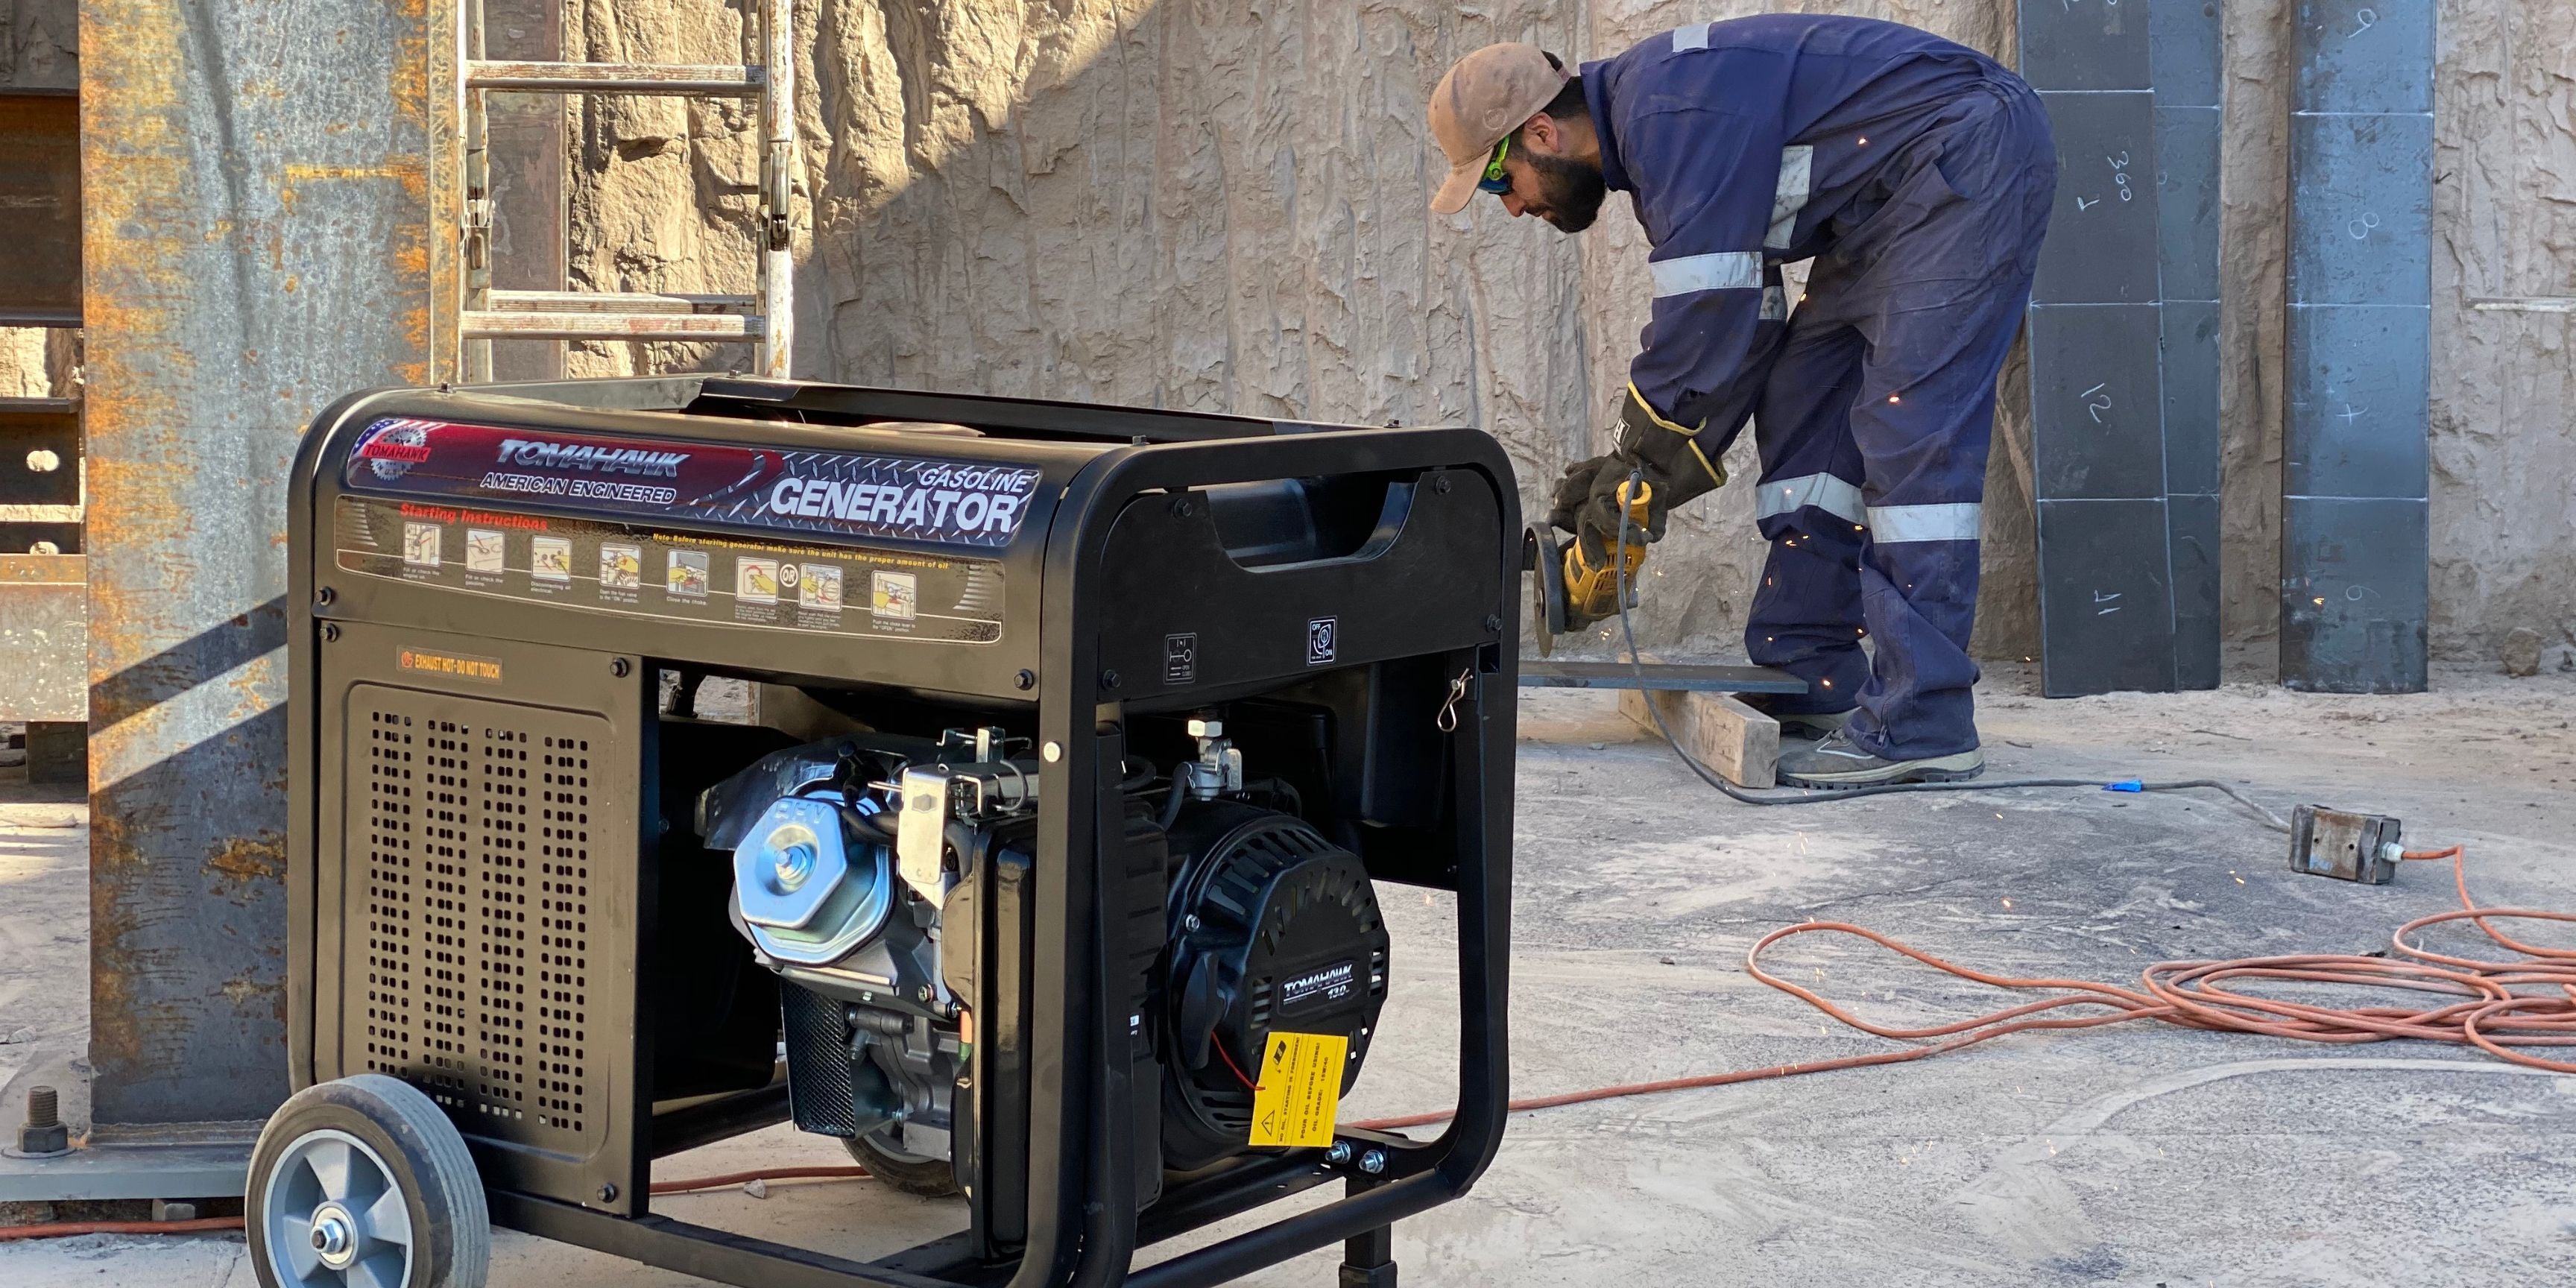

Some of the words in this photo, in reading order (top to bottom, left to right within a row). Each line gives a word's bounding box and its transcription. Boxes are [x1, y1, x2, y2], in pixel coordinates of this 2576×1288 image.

[2348, 212, 2379, 240] 8
[366, 443, 429, 461] TOMAHAWK
[496, 438, 691, 478] TOMAHAWK
[480, 471, 569, 495] AMERICAN
[568, 479, 677, 504] ENGINEERED
[919, 467, 1032, 493] GASOLINE
[400, 502, 457, 525] Starting
[460, 509, 548, 531] Instructions
[770, 477, 1019, 533] GENERATOR
[699, 538, 727, 548] starting
[729, 542, 765, 551] generator
[766, 546, 786, 554] make
[839, 552, 852, 560] has
[869, 556, 894, 565] proper
[897, 559, 925, 567] amount
[783, 569, 796, 582] OR
[415, 654, 442, 671] EXHAUST
[467, 661, 479, 676] NOT
[479, 662, 499, 679] TOUCH
[1284, 964, 1353, 998] TOMAHAWK
[1284, 1085, 1292, 1115] STARTING
[1307, 1071, 1316, 1100] BEFORE
